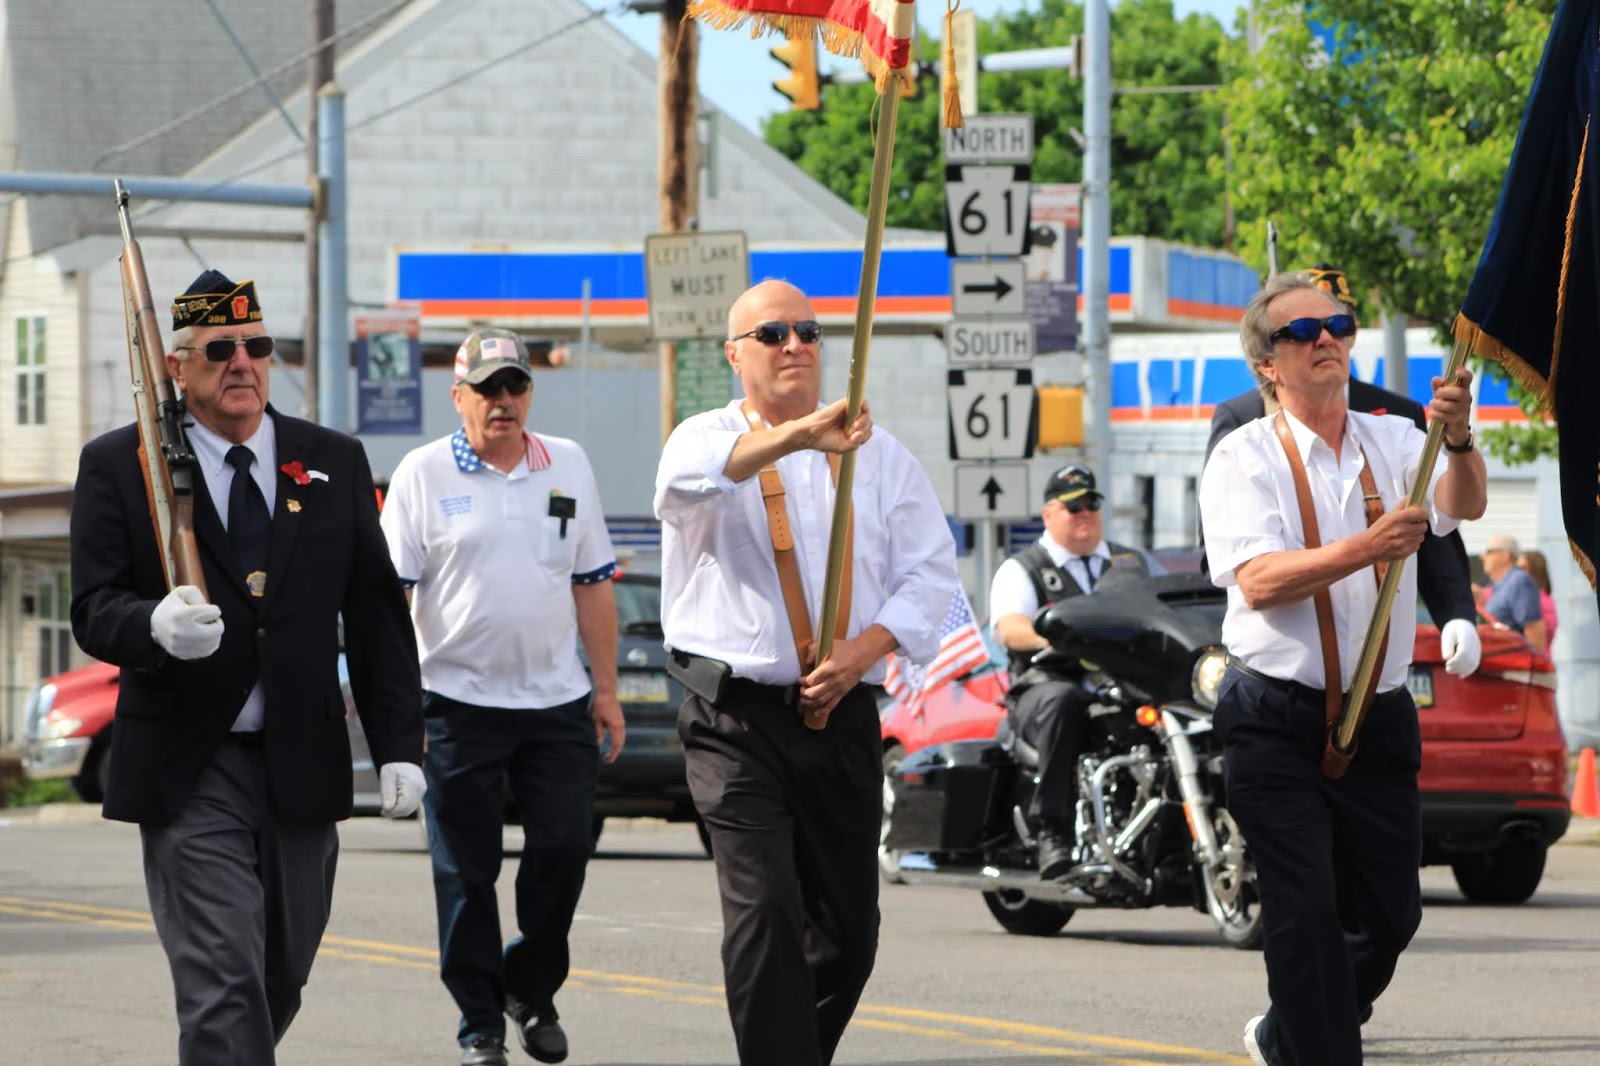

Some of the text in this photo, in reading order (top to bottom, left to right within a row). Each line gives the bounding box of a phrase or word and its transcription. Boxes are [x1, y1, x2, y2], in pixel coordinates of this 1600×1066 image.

[951, 127, 1025, 151] NORTH
[960, 189, 1012, 236] 61
[700, 244, 738, 264] LANE
[671, 273, 725, 297] MUST
[706, 308, 730, 325] LE
[955, 327, 1028, 356] SOUTH
[966, 393, 1009, 438] 61
